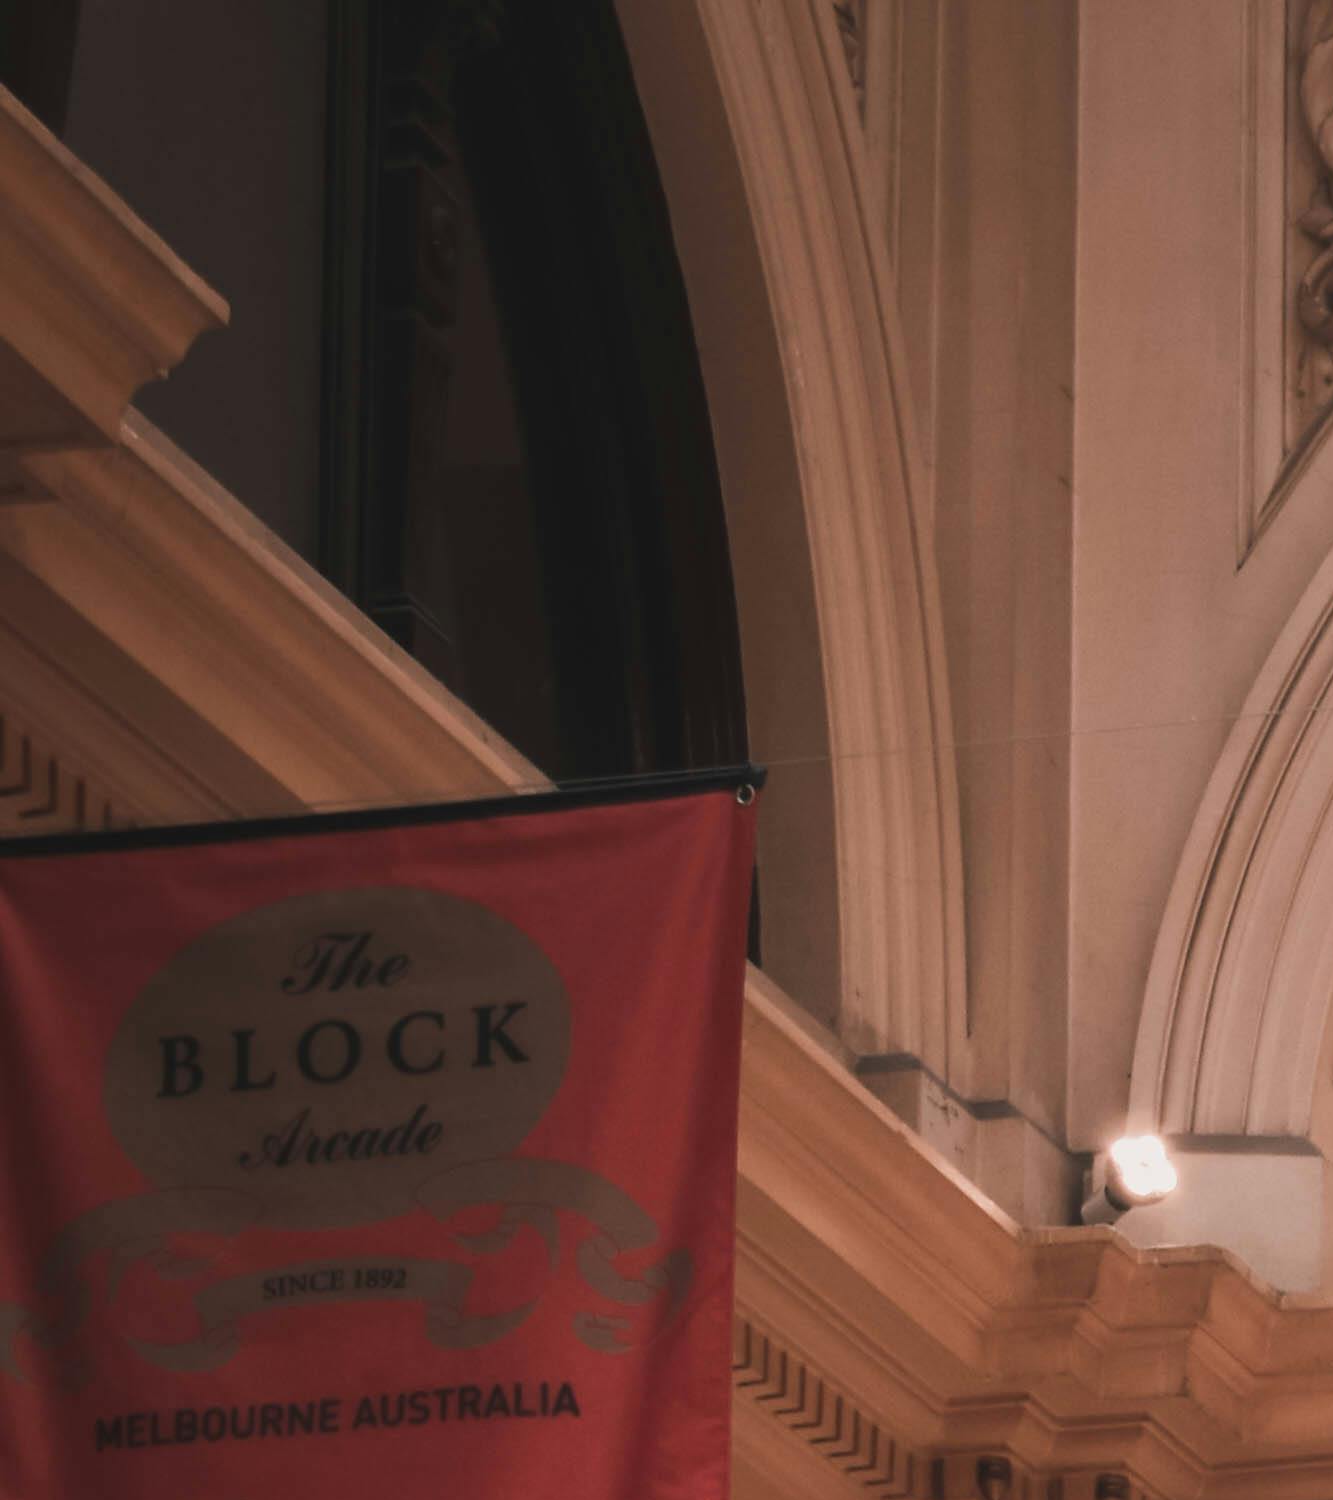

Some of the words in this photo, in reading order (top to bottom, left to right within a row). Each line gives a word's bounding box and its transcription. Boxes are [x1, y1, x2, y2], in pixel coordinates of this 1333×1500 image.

[281, 931, 412, 994] The
[156, 1001, 530, 1099] BLOCK
[239, 1103, 444, 1172] Arcade
[261, 1269, 345, 1300] SINCE
[354, 1267, 408, 1291] 1892
[94, 1397, 341, 1453] MELBOURNE
[353, 1381, 581, 1430] AUSTRALIA
